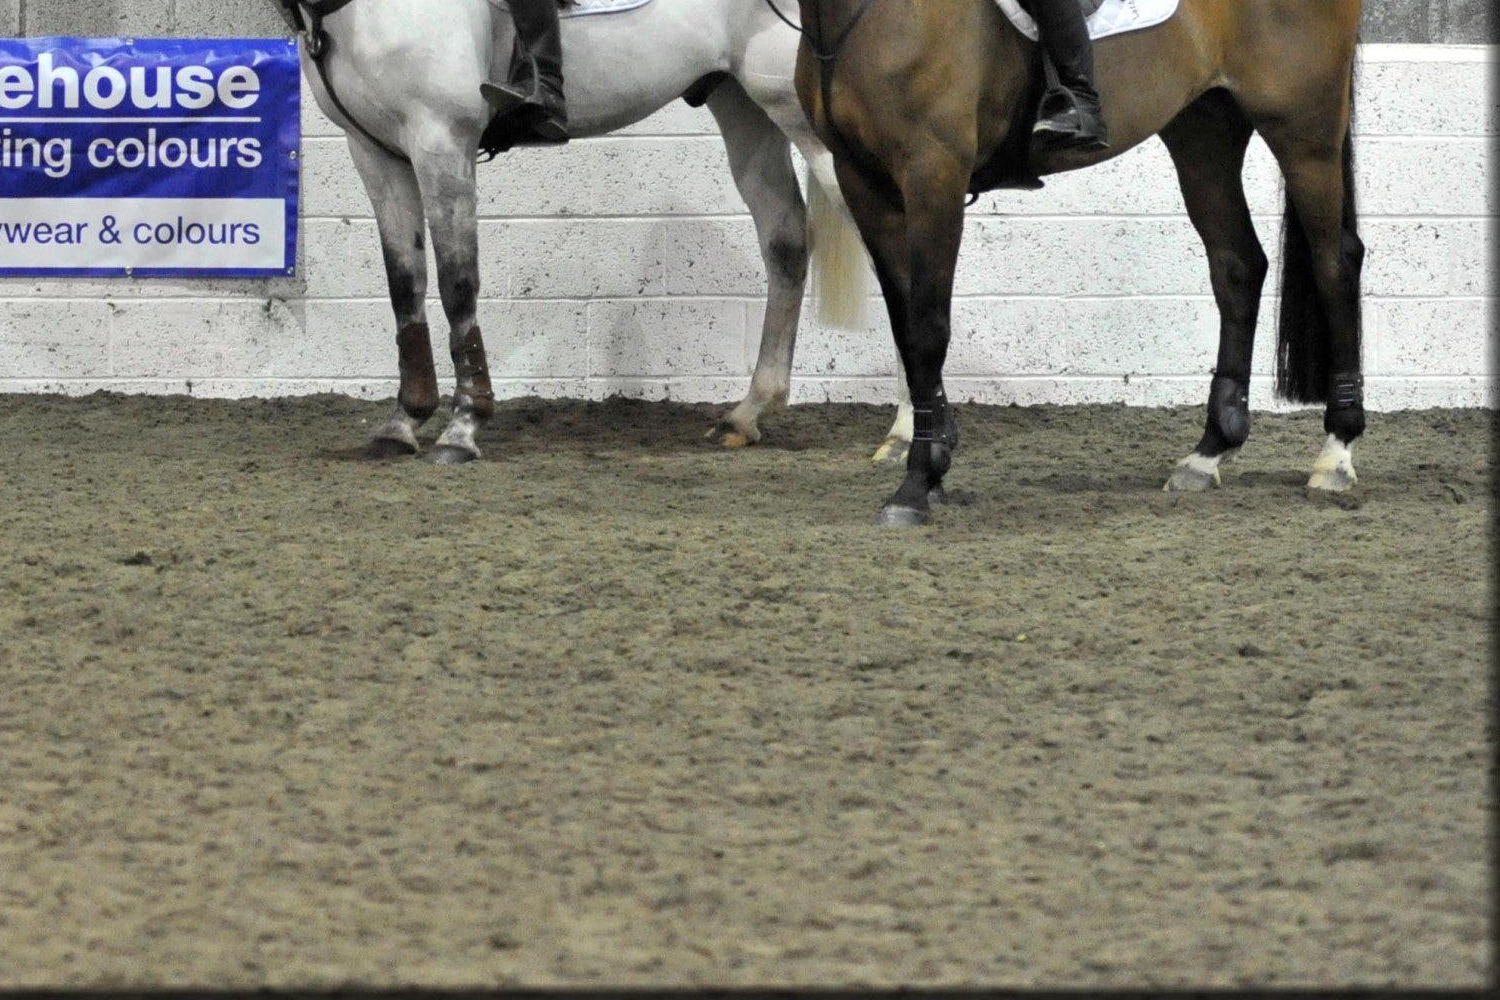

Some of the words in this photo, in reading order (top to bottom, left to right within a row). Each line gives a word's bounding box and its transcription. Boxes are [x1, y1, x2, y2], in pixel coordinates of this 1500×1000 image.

[87, 129, 262, 169] colours
[98, 216, 121, 245] &
[131, 216, 260, 246] colours
